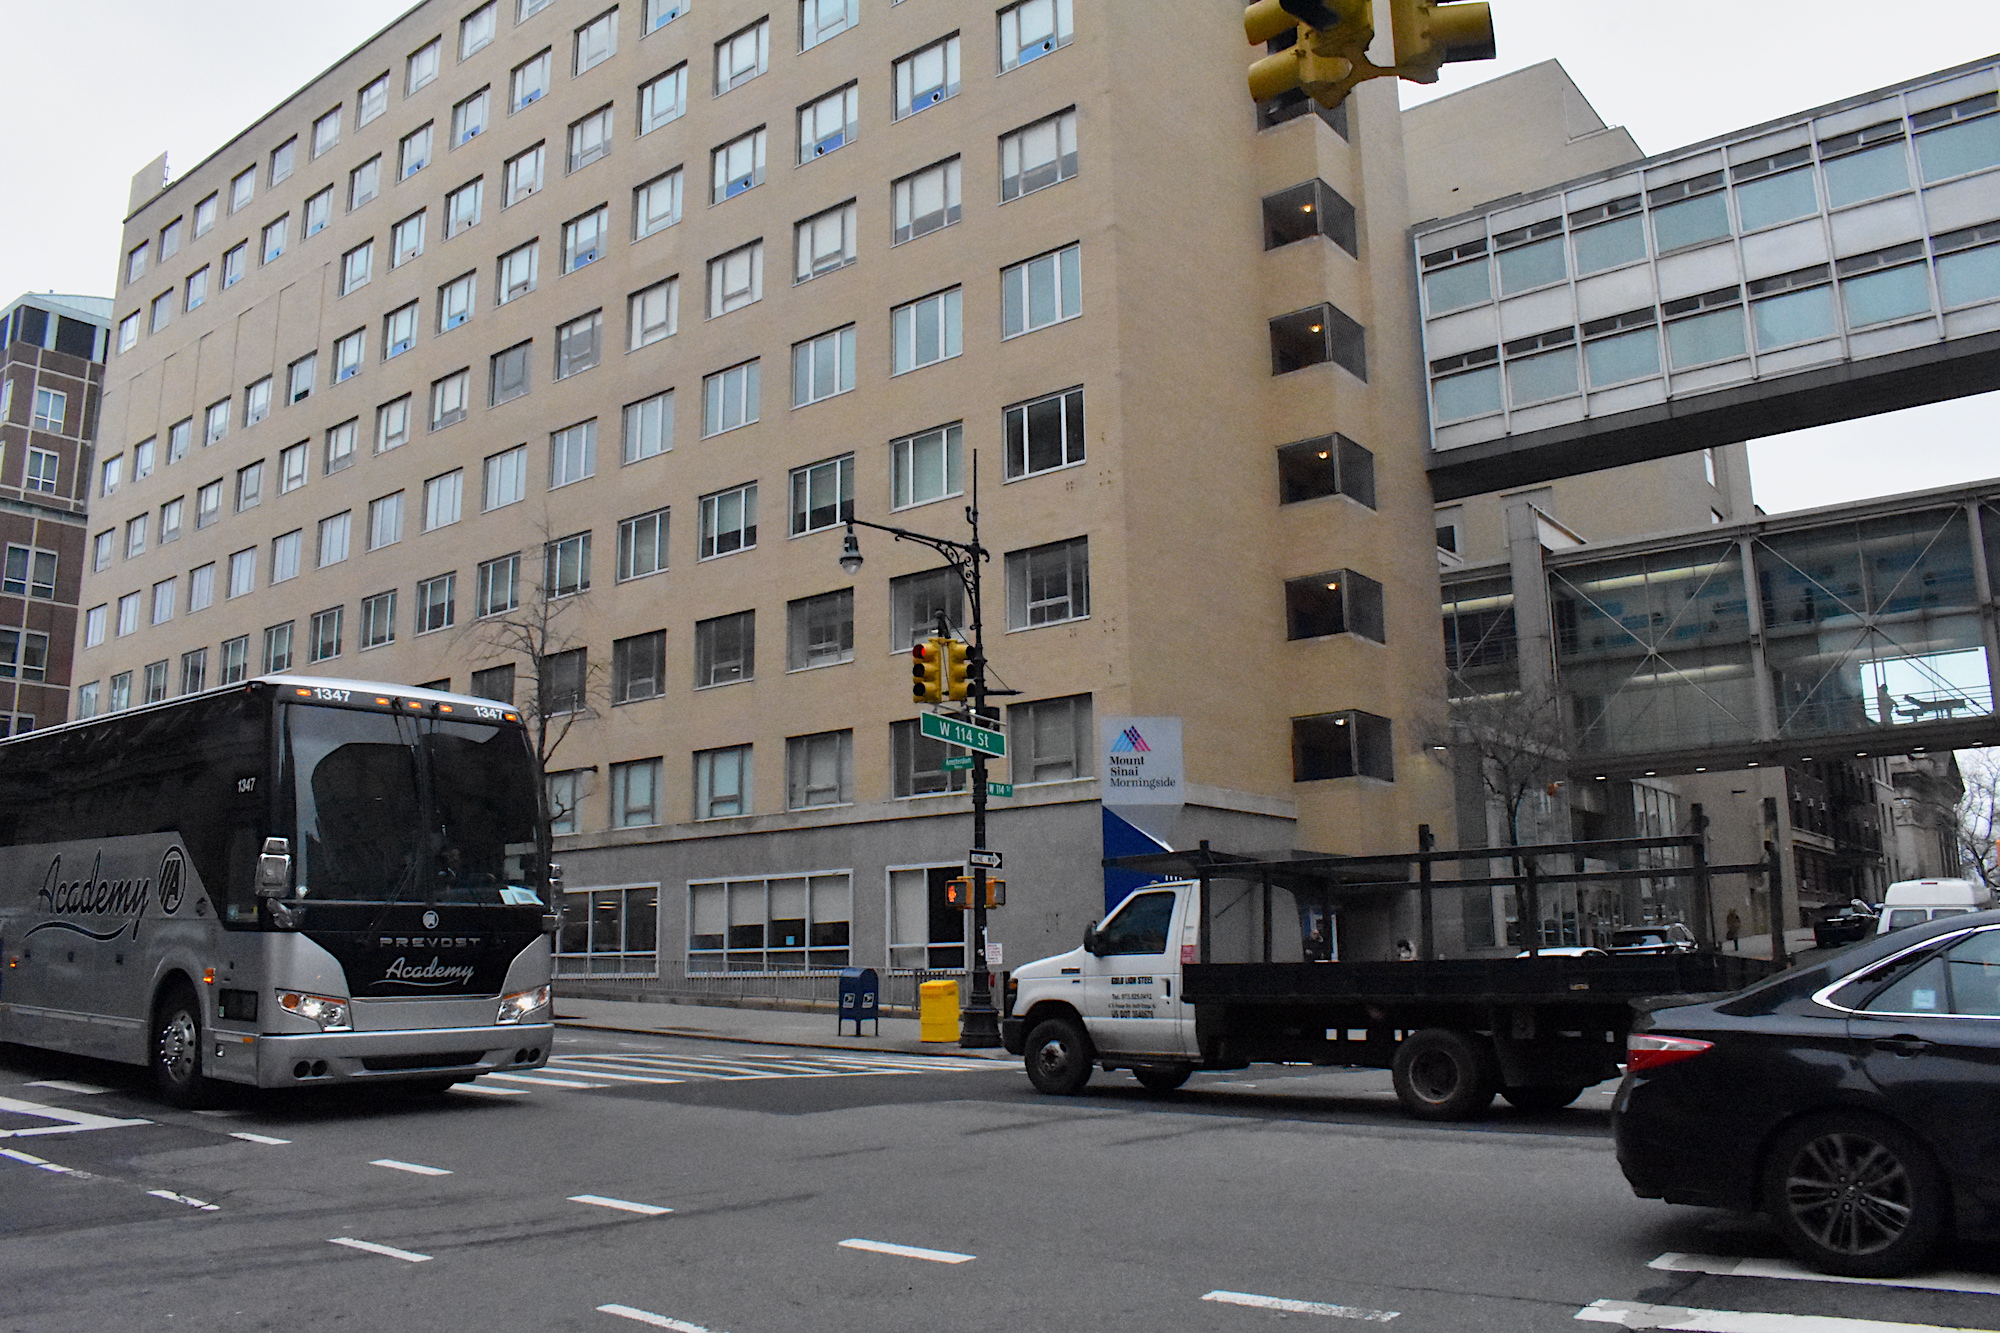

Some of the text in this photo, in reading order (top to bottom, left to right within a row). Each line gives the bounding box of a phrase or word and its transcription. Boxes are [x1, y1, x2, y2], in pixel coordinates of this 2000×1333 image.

[314, 687, 350, 702] 1347
[473, 706, 504, 720] 1347
[939, 720, 989, 748] W 114 St
[1109, 756, 1145, 765] Mount
[1110, 766, 1139, 776] Sinai
[237, 777, 256, 793] 1347
[989, 783, 994, 794] W
[996, 784, 1005, 795] 114
[1110, 777, 1176, 790] Morningside
[36, 846, 151, 942] Academy
[380, 937, 481, 948] PREVOST
[385, 955, 475, 986] Academy
[1138, 976, 1153, 984] STEEL
